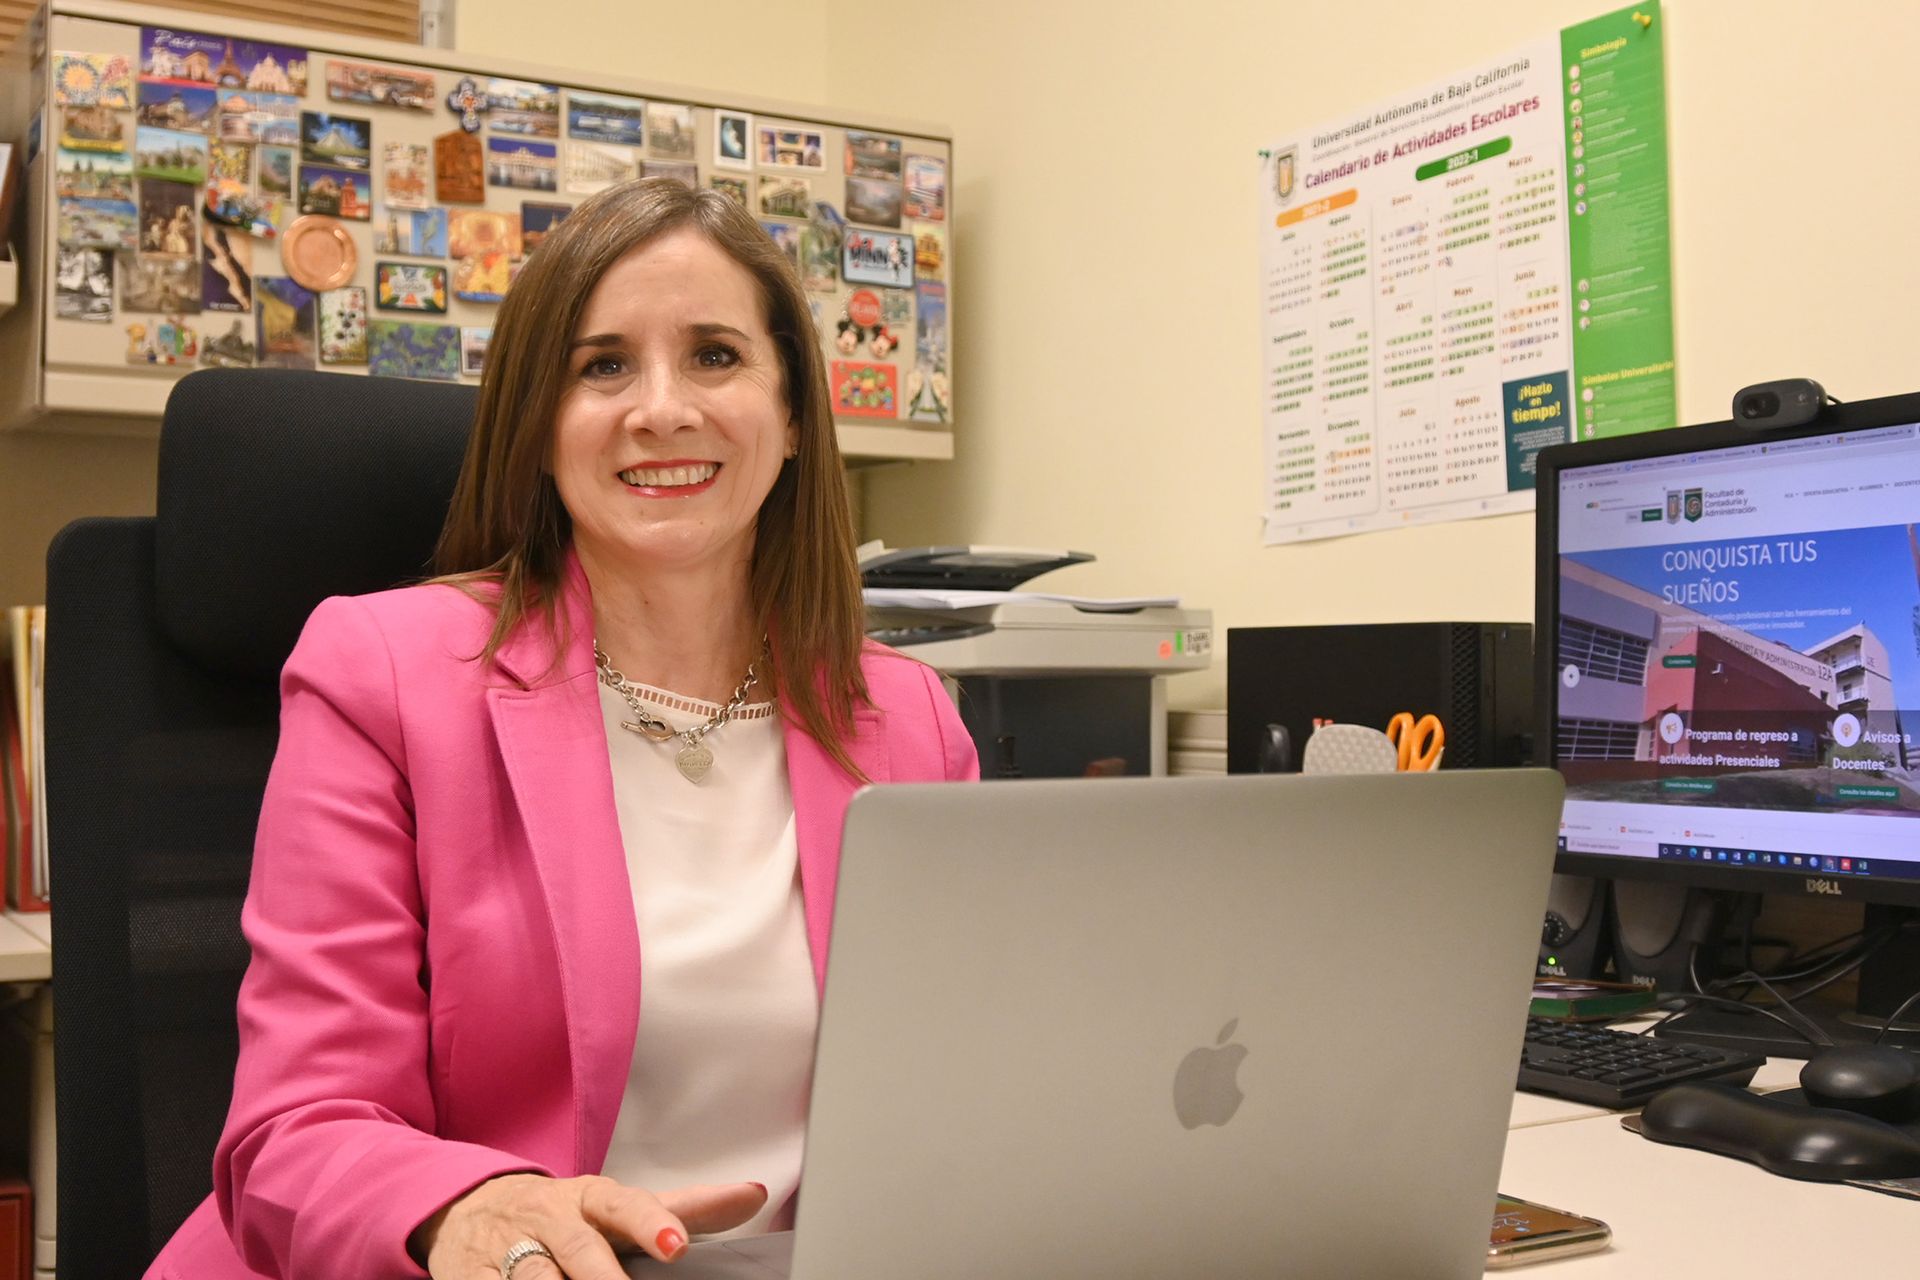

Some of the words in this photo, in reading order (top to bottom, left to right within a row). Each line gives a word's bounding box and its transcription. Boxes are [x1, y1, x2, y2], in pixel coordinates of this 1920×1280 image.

[1312, 117, 1372, 148] Universidad
[1374, 98, 1429, 125] Autónoma
[1431, 90, 1445, 105] de
[1448, 82, 1472, 101] Baja
[1475, 57, 1531, 89] California
[1304, 158, 1371, 190] Calendario
[1374, 148, 1389, 165] de
[1392, 120, 1468, 160] Actividades
[1471, 94, 1541, 132] Escolares
[1529, 397, 1542, 406] en
[1511, 400, 1562, 424] tiempo!
[1704, 490, 1736, 499] Facultad
[1736, 488, 1746, 497] de
[1661, 543, 1773, 573] CONQUISTA
[1776, 539, 1818, 564] TUS
[1661, 577, 1740, 605] SUEÑOS
[1818, 664, 1834, 682] 12A
[1684, 728, 1733, 744] Programa
[1734, 729, 1748, 742] de
[1749, 731, 1790, 745] regreso
[1791, 733, 1799, 743] a
[1862, 730, 1901, 744] Avisos
[1902, 734, 1912, 744] a
[1659, 753, 1714, 766] actividades
[1714, 754, 1781, 768] Presenciales
[1832, 756, 1885, 771] Docentes
[1839, 788, 1860, 796] Consulta
[1806, 878, 1842, 895] DELL
[1539, 964, 1567, 977] DELL
[1632, 975, 1657, 987] DELL
